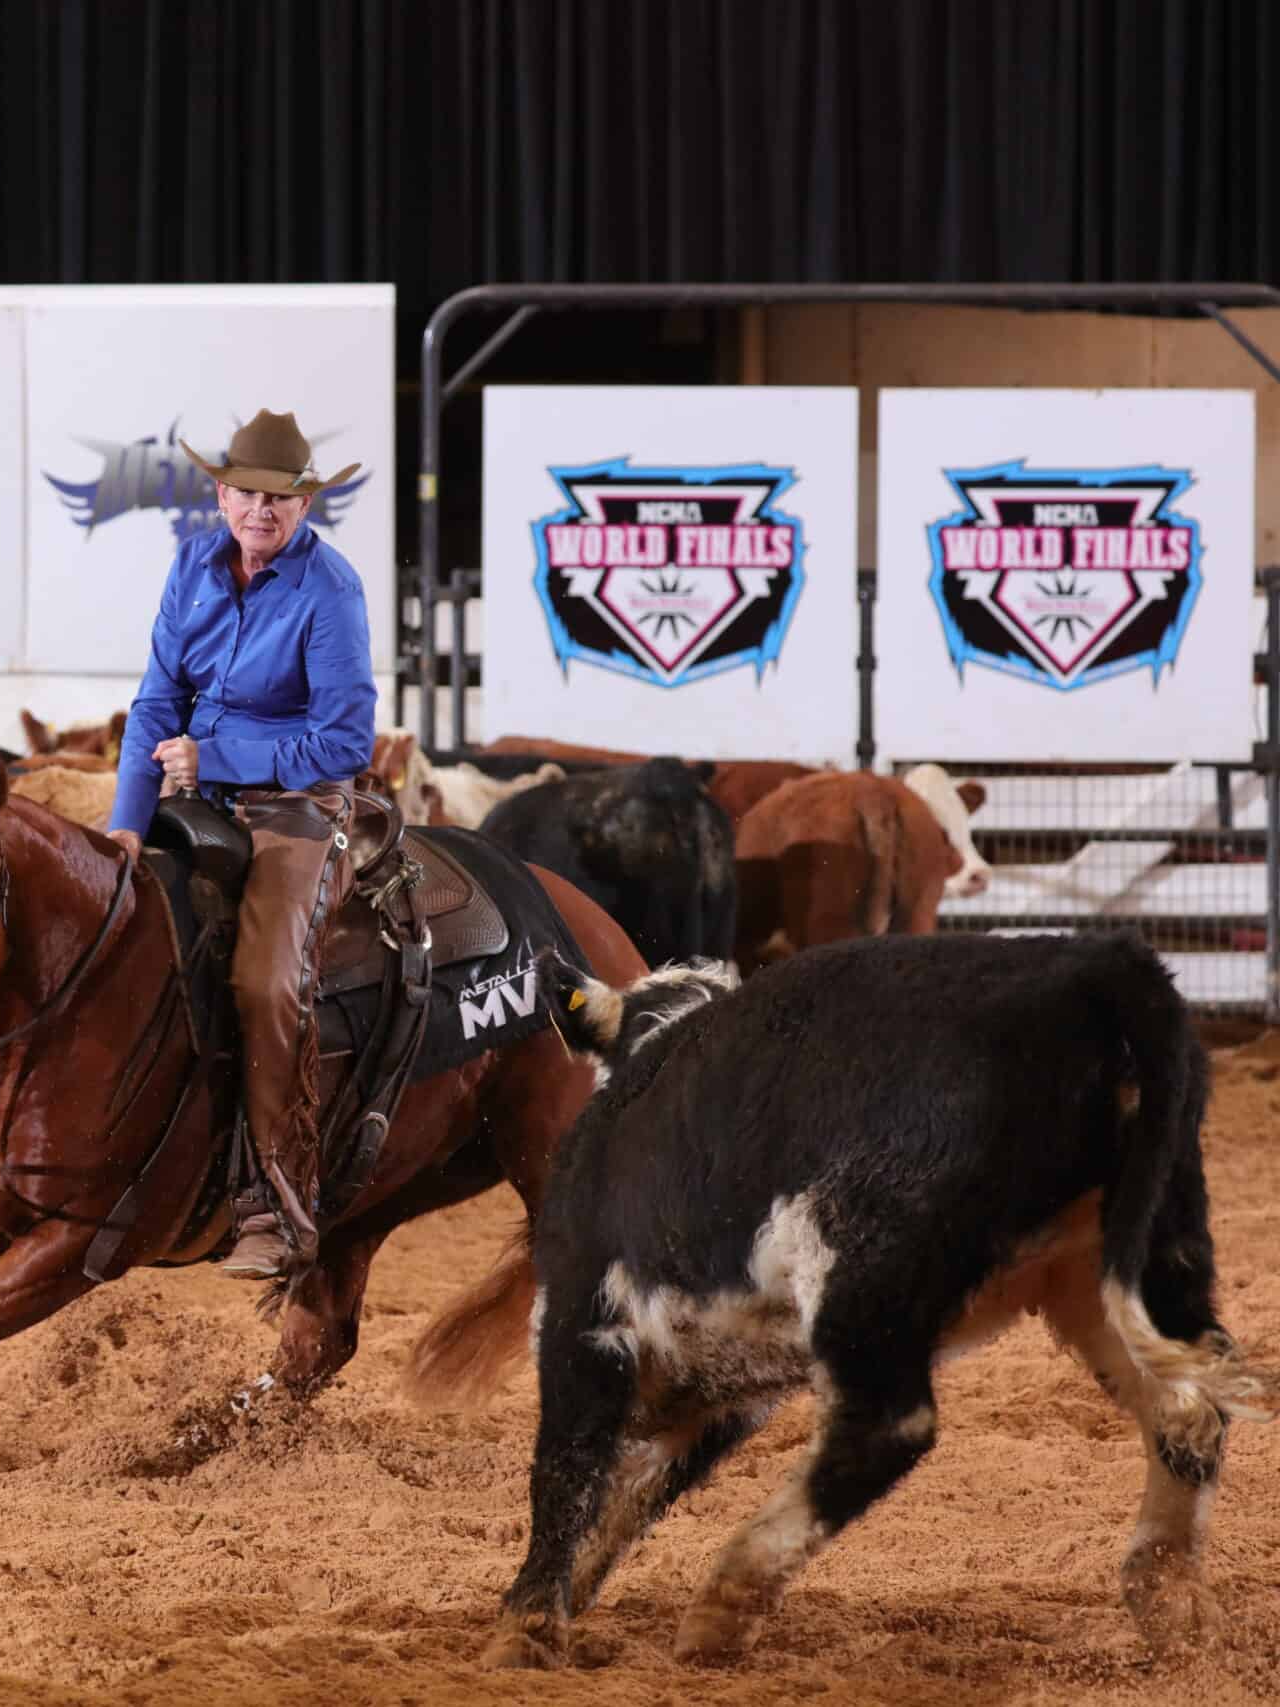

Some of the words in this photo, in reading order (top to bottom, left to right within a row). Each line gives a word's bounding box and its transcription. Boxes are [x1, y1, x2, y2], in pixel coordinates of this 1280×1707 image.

[546, 525, 668, 567] WORLD
[675, 525, 794, 567] FINALS
[941, 527, 1063, 570] WORLD
[1071, 527, 1191, 570] FINALS
